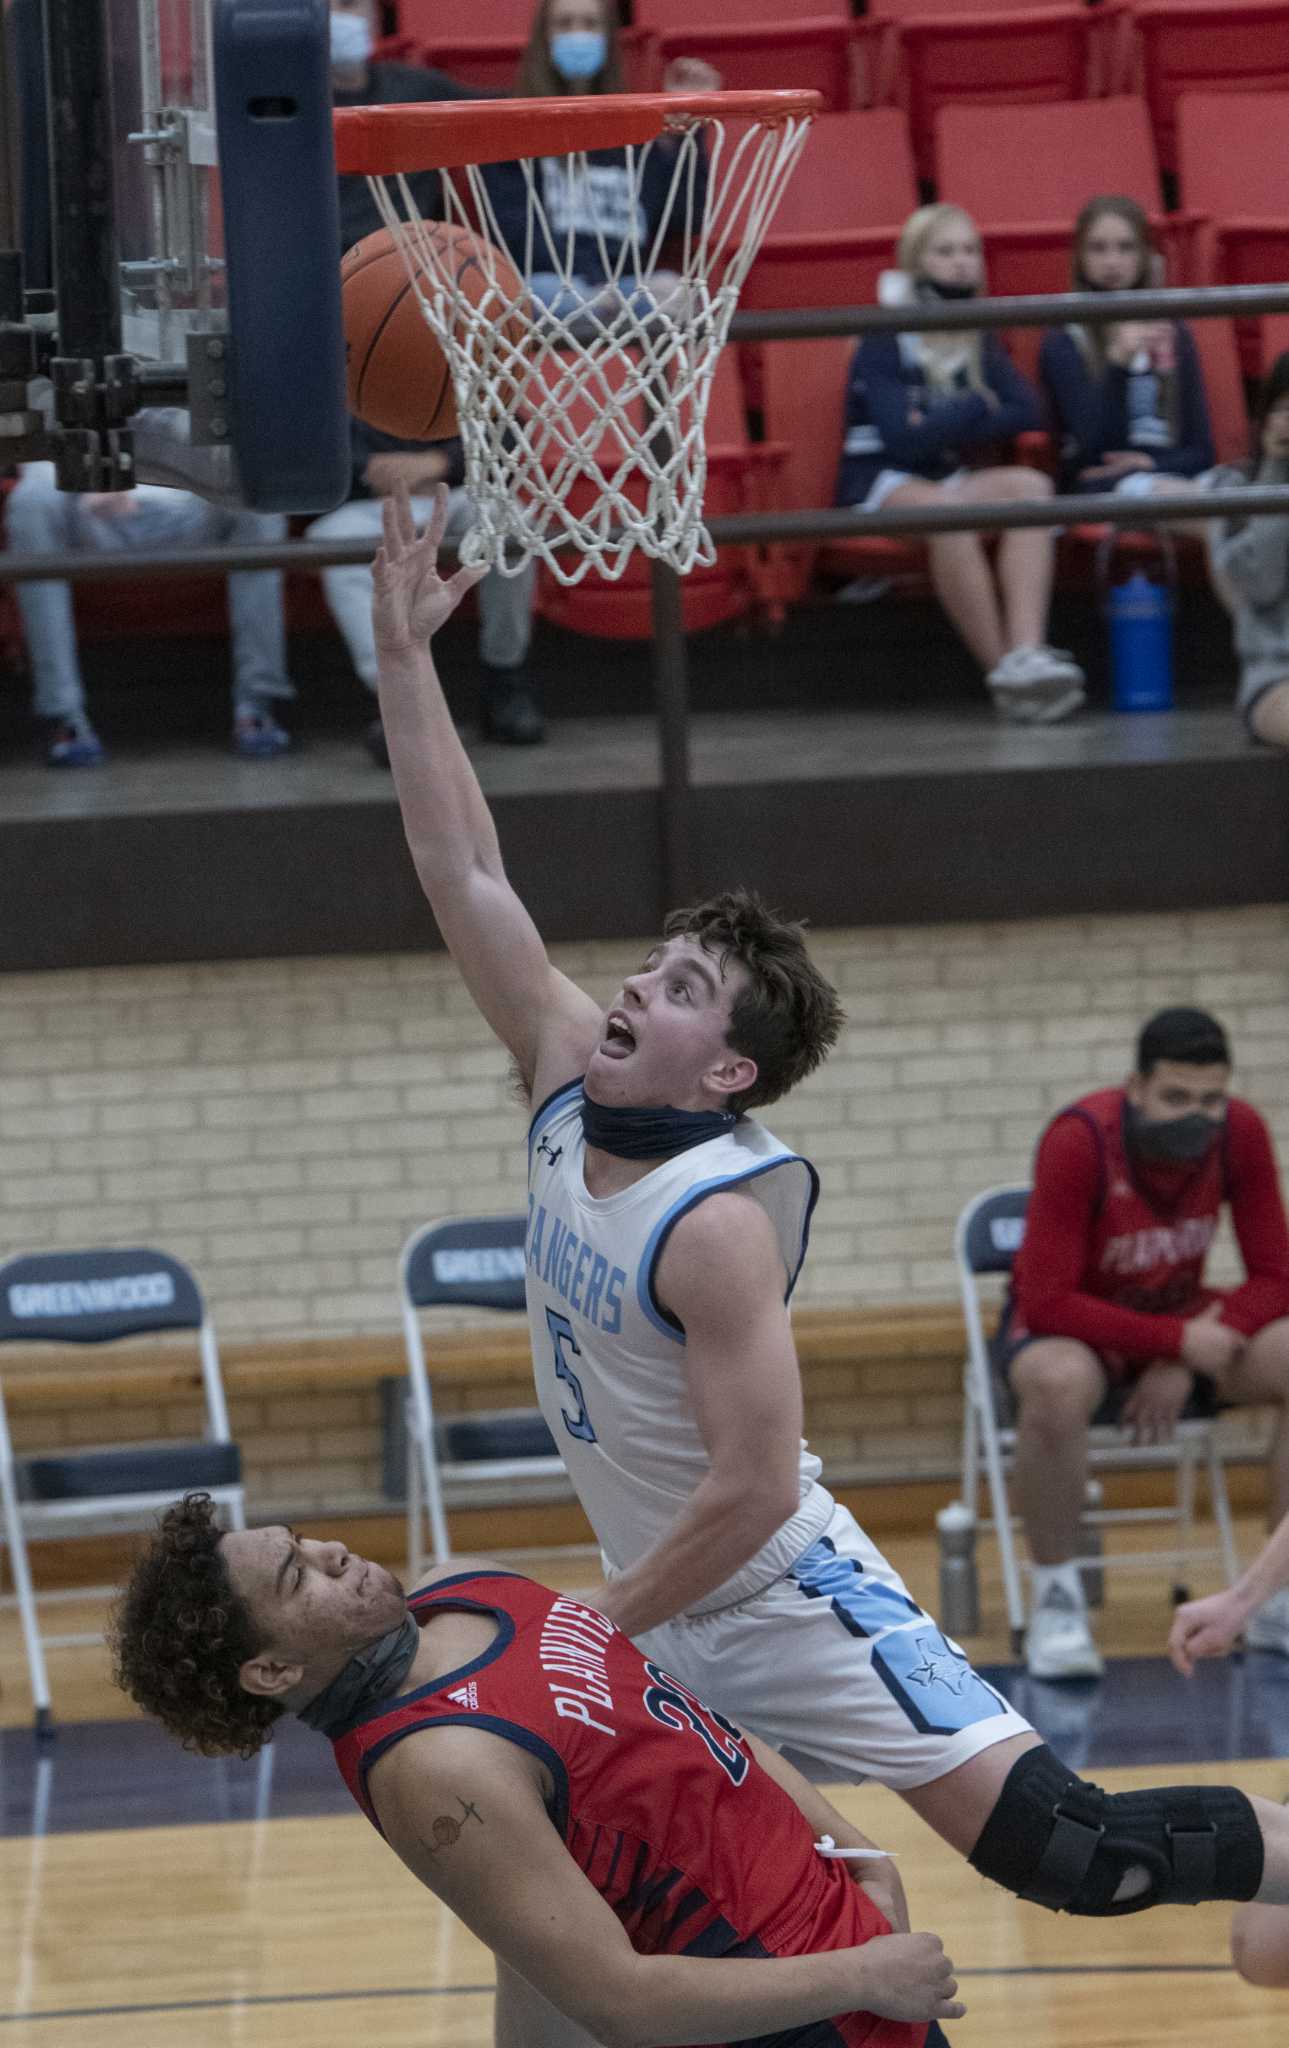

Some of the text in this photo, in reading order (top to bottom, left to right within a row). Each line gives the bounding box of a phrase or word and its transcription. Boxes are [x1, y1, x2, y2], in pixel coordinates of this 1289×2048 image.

[527, 1193, 627, 1335] ANGERS
[545, 1303, 598, 1444] 5
[540, 1595, 621, 1736] PLAINVIE
